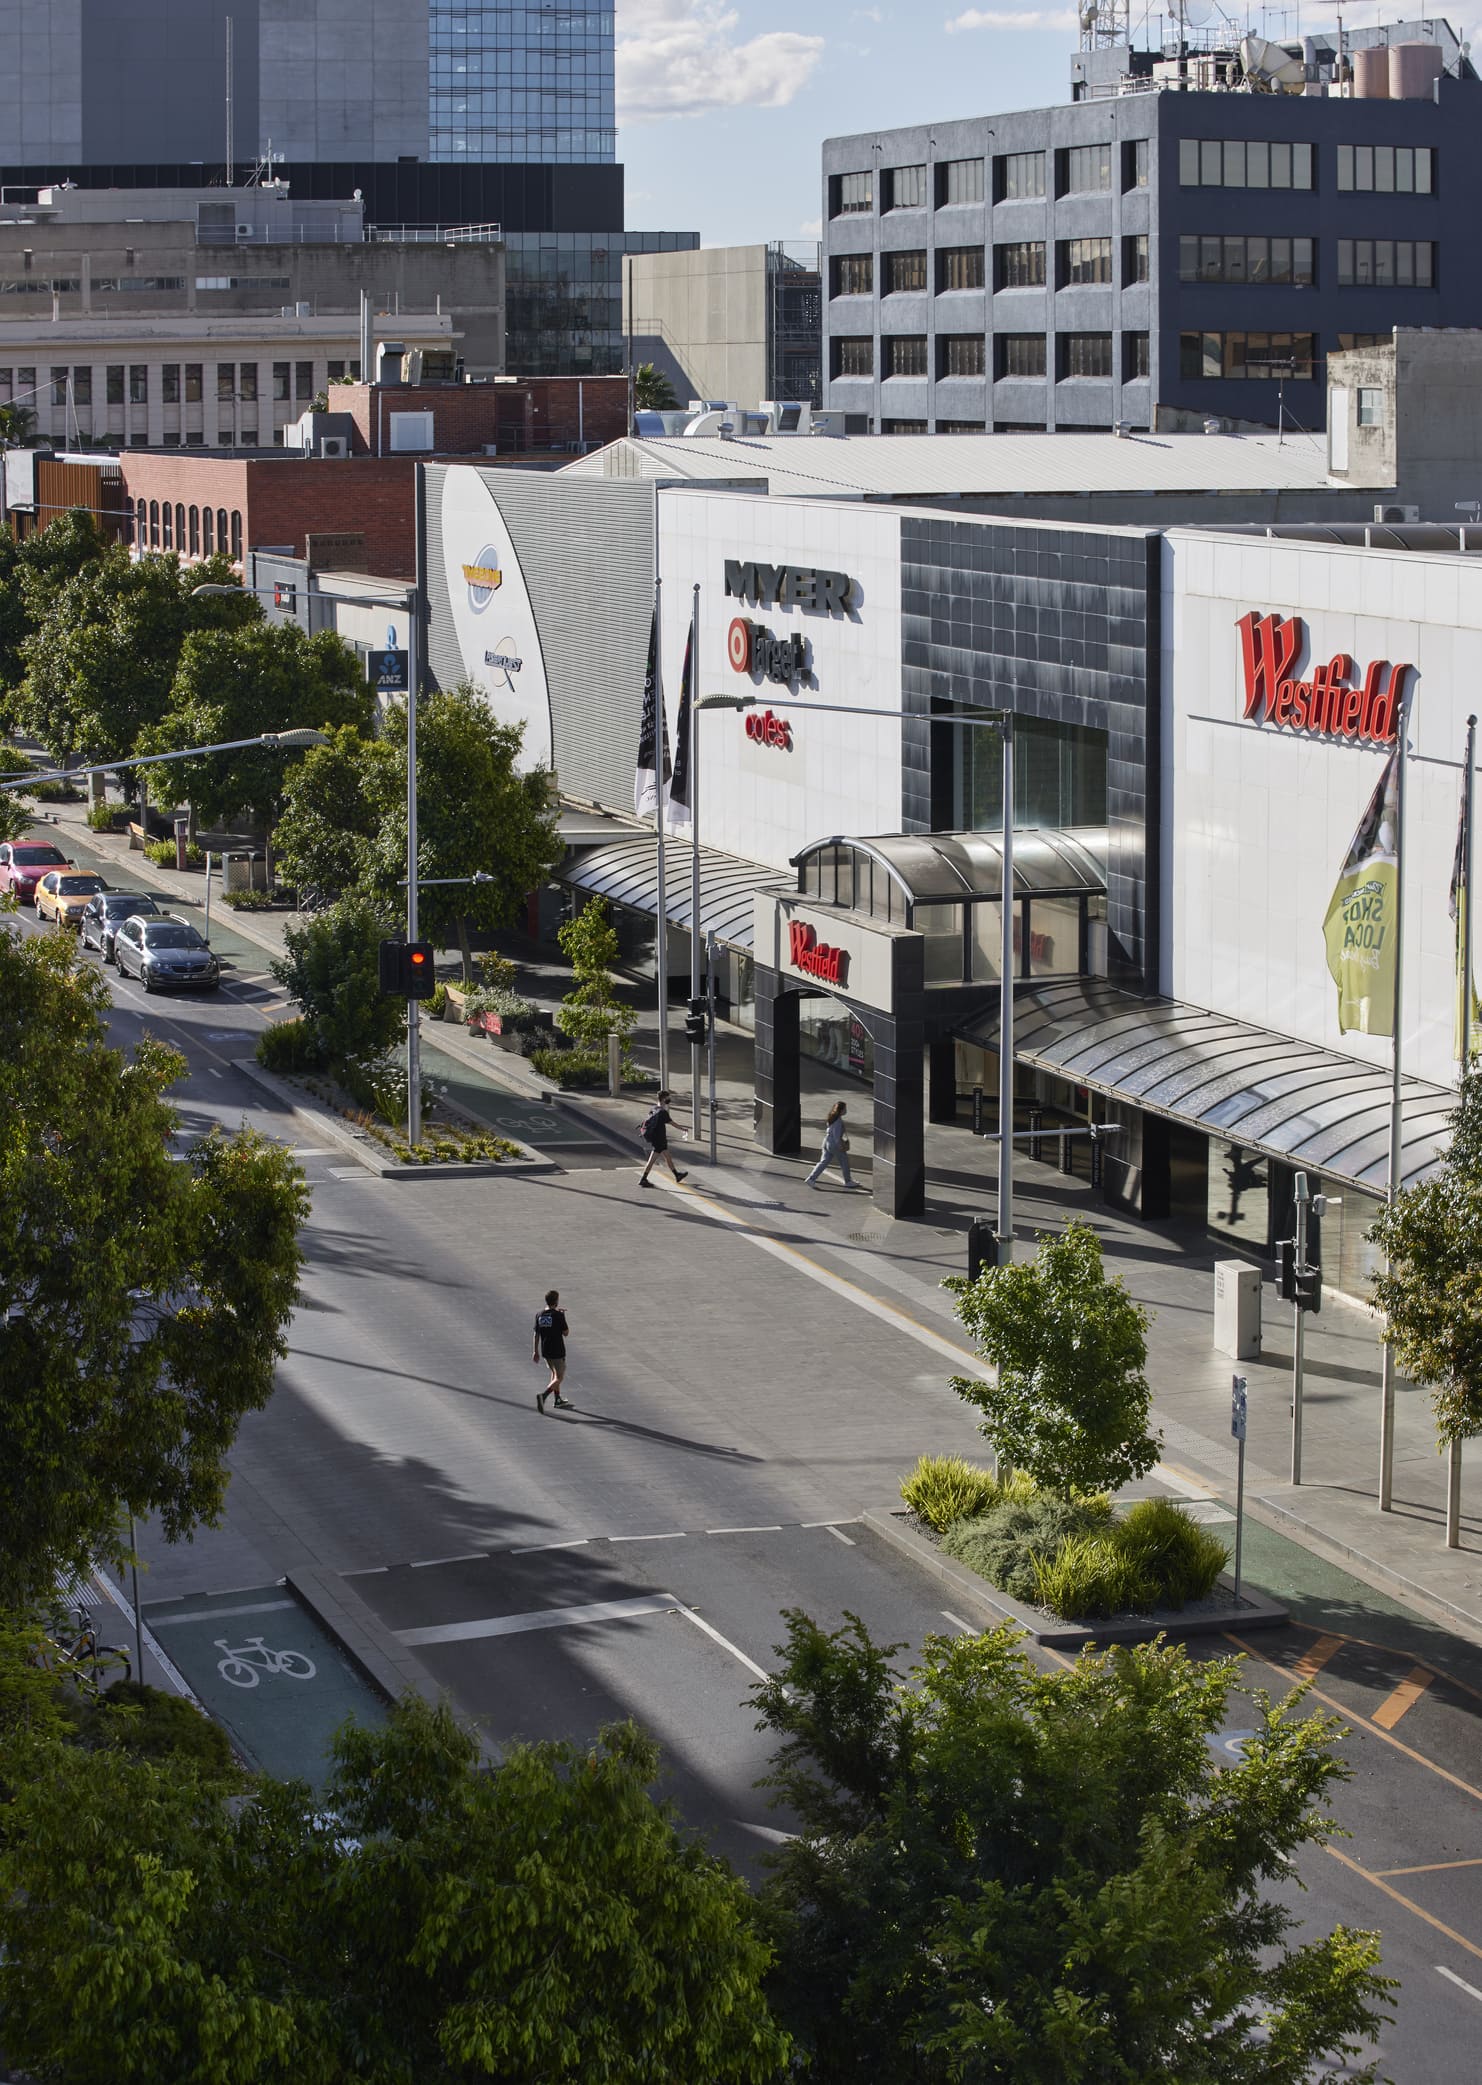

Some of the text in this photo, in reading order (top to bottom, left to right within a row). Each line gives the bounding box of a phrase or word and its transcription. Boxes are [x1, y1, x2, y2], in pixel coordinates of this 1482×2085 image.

[724, 559, 850, 613] MYER
[377, 674, 402, 685] ANZ
[748, 622, 806, 684] Target
[1234, 611, 1404, 745] Westfield
[745, 710, 787, 747] coles
[787, 920, 845, 984] Westfield
